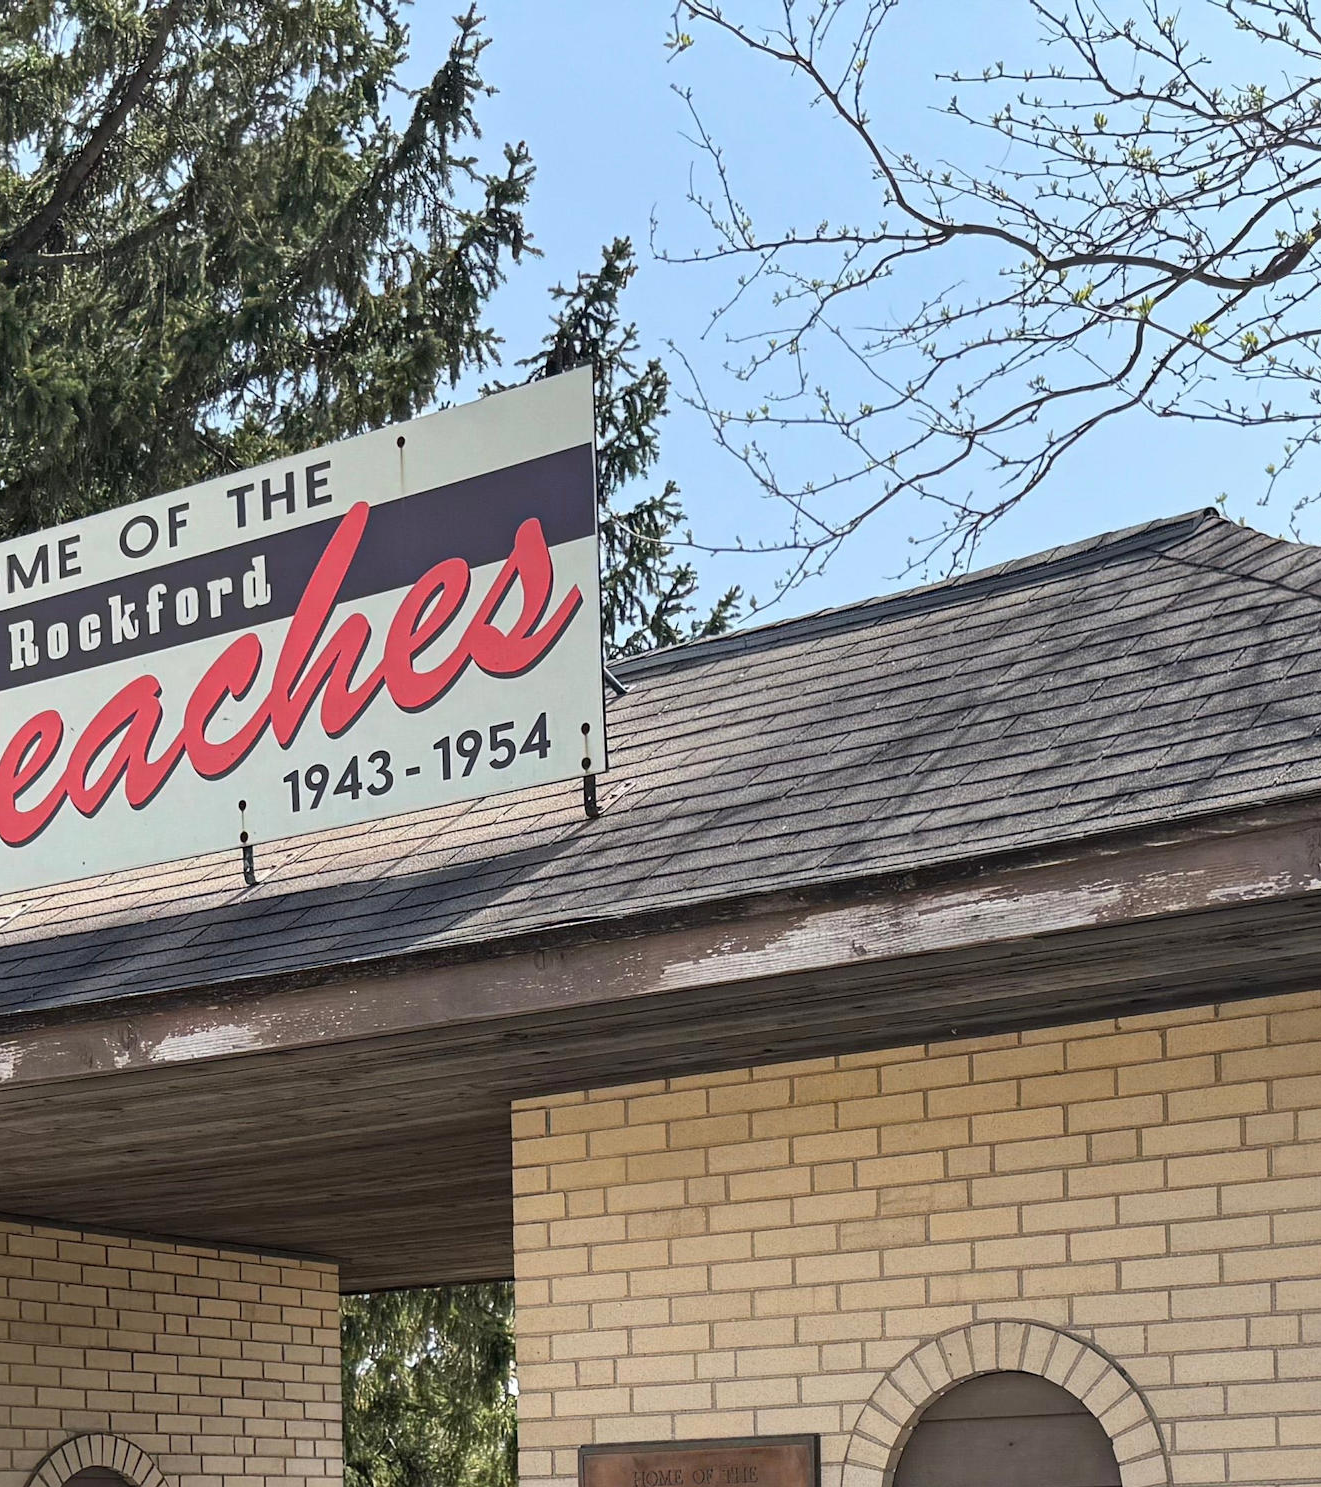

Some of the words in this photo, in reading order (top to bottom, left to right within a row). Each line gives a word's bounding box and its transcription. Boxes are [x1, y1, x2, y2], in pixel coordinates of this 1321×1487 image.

[119, 502, 190, 558] OF
[226, 460, 333, 529] THE
[8, 554, 272, 671] Rockford
[633, 1469, 684, 1487] HOME
[692, 1468, 714, 1485] OF
[722, 1466, 759, 1484] THE
